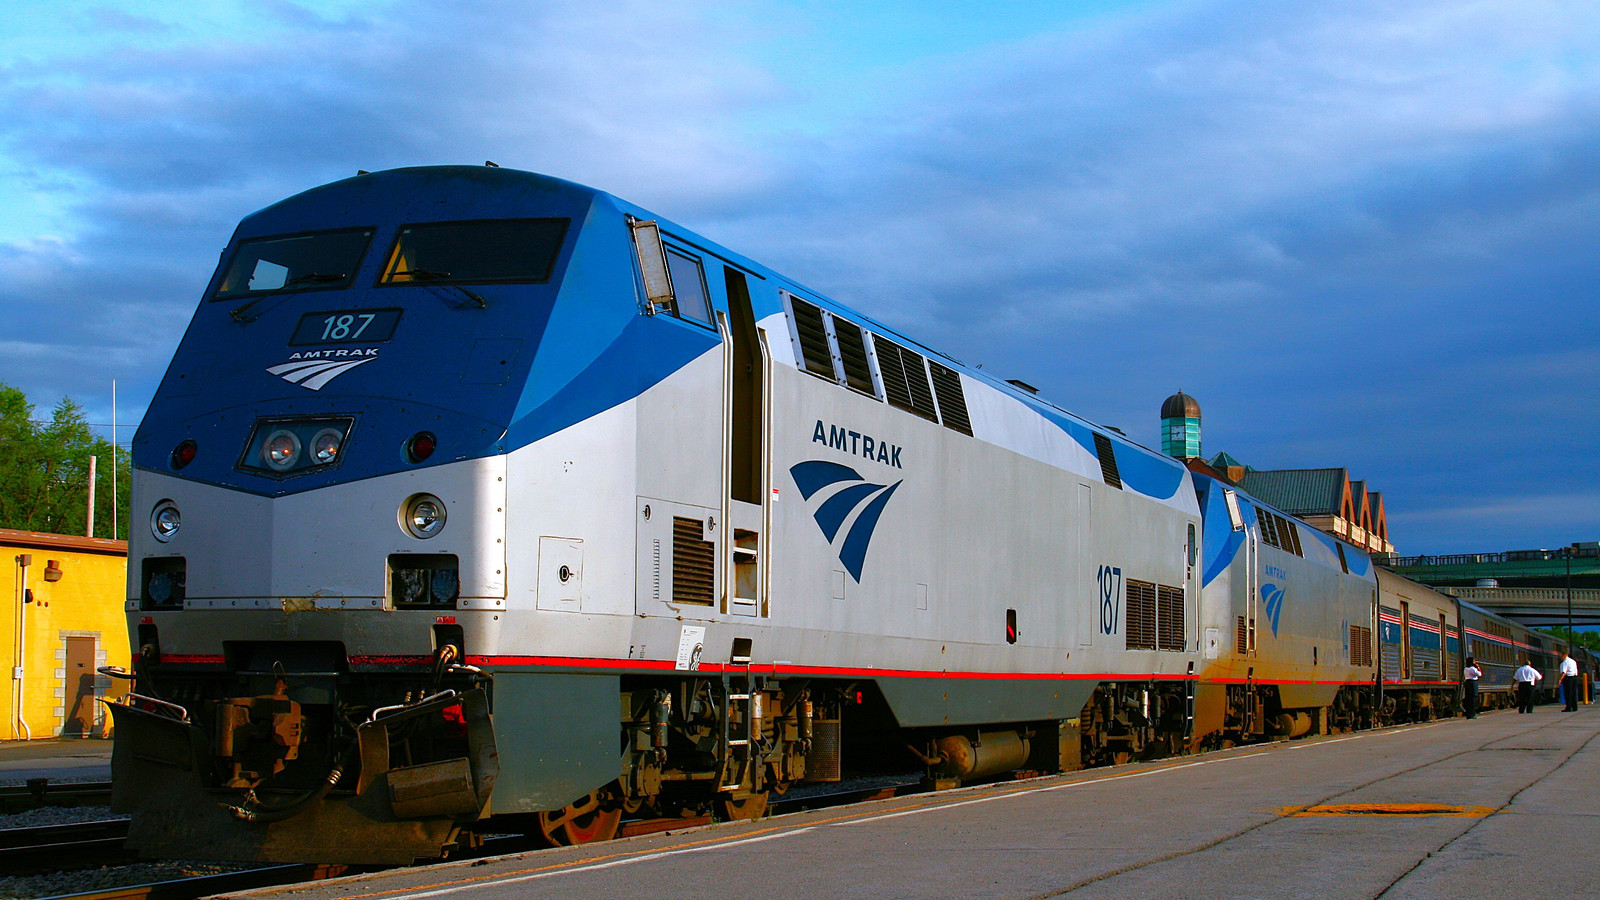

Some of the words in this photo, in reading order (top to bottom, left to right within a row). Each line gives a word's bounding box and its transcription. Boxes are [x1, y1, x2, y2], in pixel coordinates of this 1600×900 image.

[321, 313, 376, 340] 187
[288, 348, 379, 360] AMTRAK
[812, 419, 902, 469] AMTRAK
[1097, 564, 1121, 635] 187
